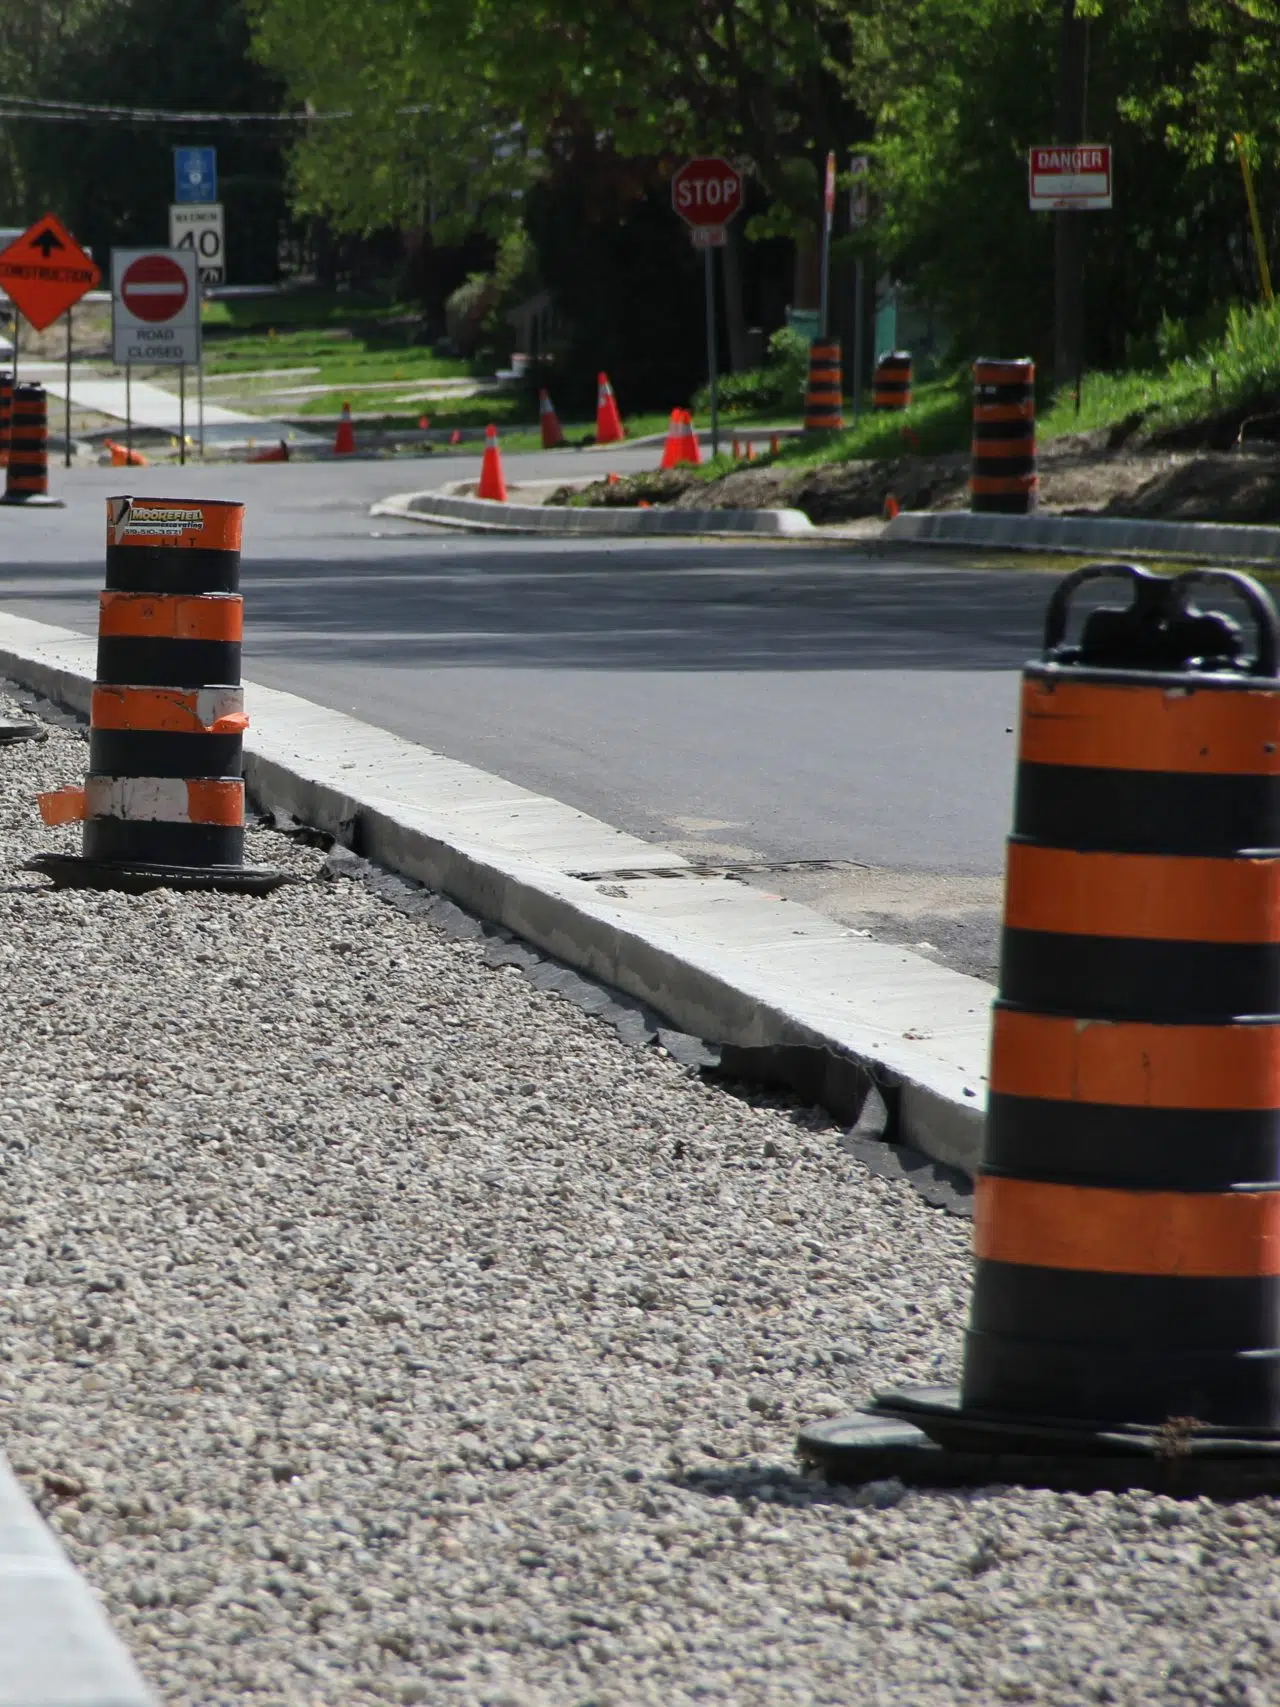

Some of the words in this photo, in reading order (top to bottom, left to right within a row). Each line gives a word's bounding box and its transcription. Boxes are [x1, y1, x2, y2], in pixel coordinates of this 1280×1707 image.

[1038, 151, 1102, 169] DANGER
[678, 178, 737, 206] STOP
[177, 229, 220, 258] 40
[136, 329, 175, 341] ROAD
[127, 345, 184, 358] CLOSED
[160, 521, 202, 530] excavating
